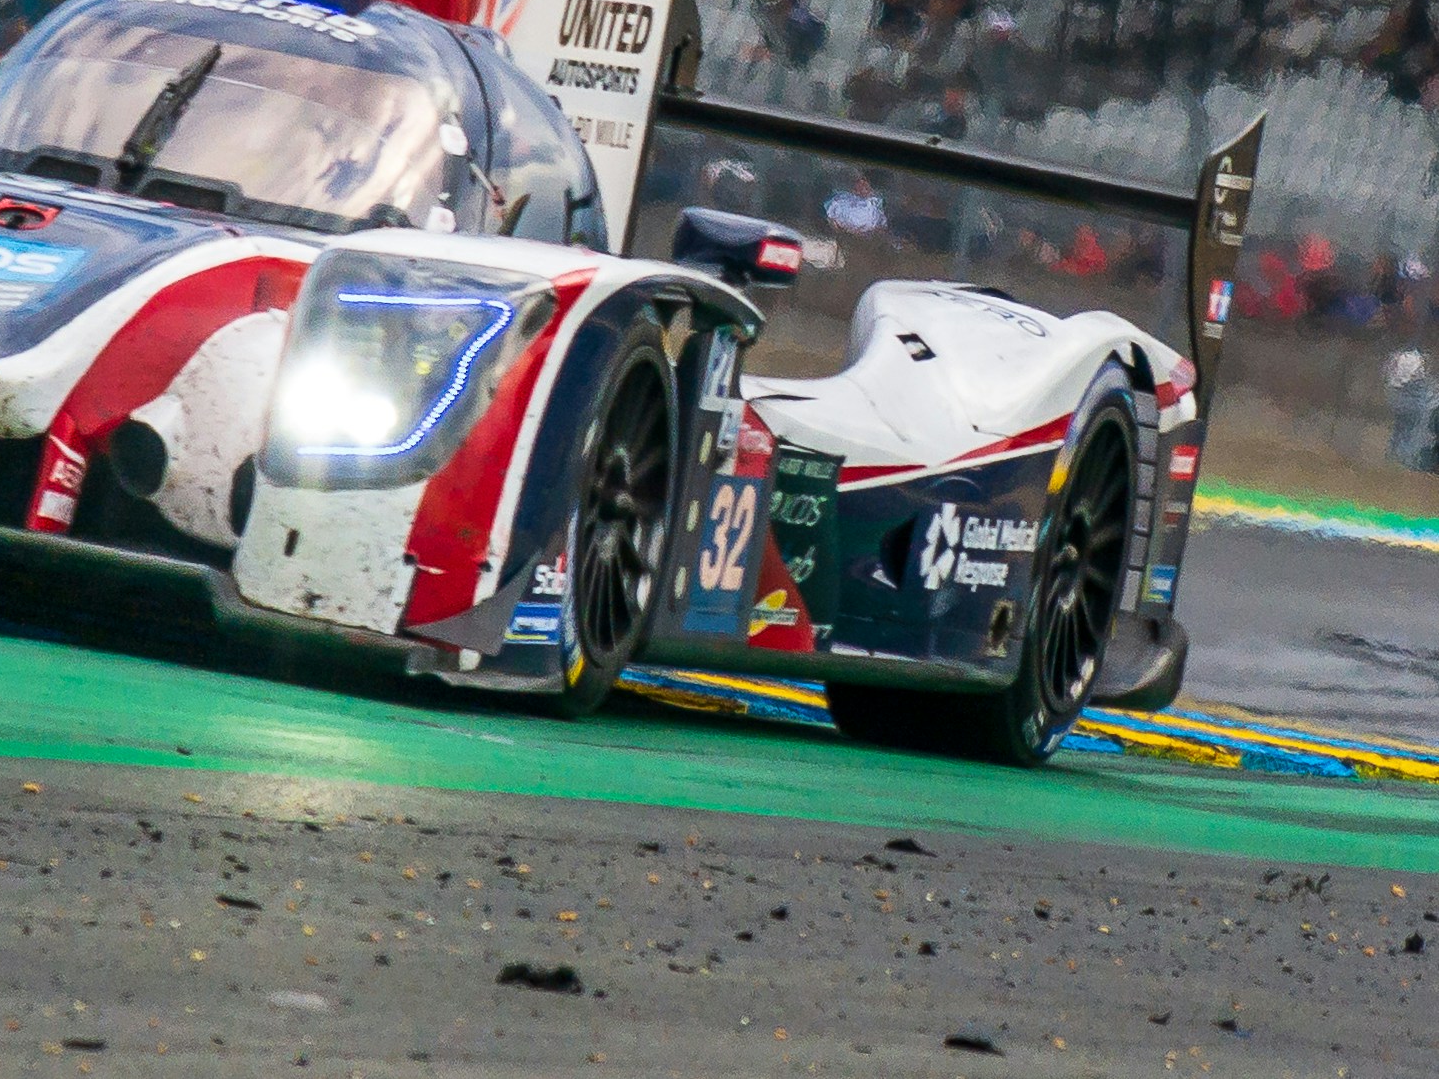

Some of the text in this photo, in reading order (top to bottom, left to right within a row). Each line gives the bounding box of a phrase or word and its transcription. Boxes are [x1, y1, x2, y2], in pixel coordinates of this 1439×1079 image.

[546, 58, 641, 95] AUTOSPORTS
[699, 484, 757, 591] 32
[954, 551, 1009, 592] Response
